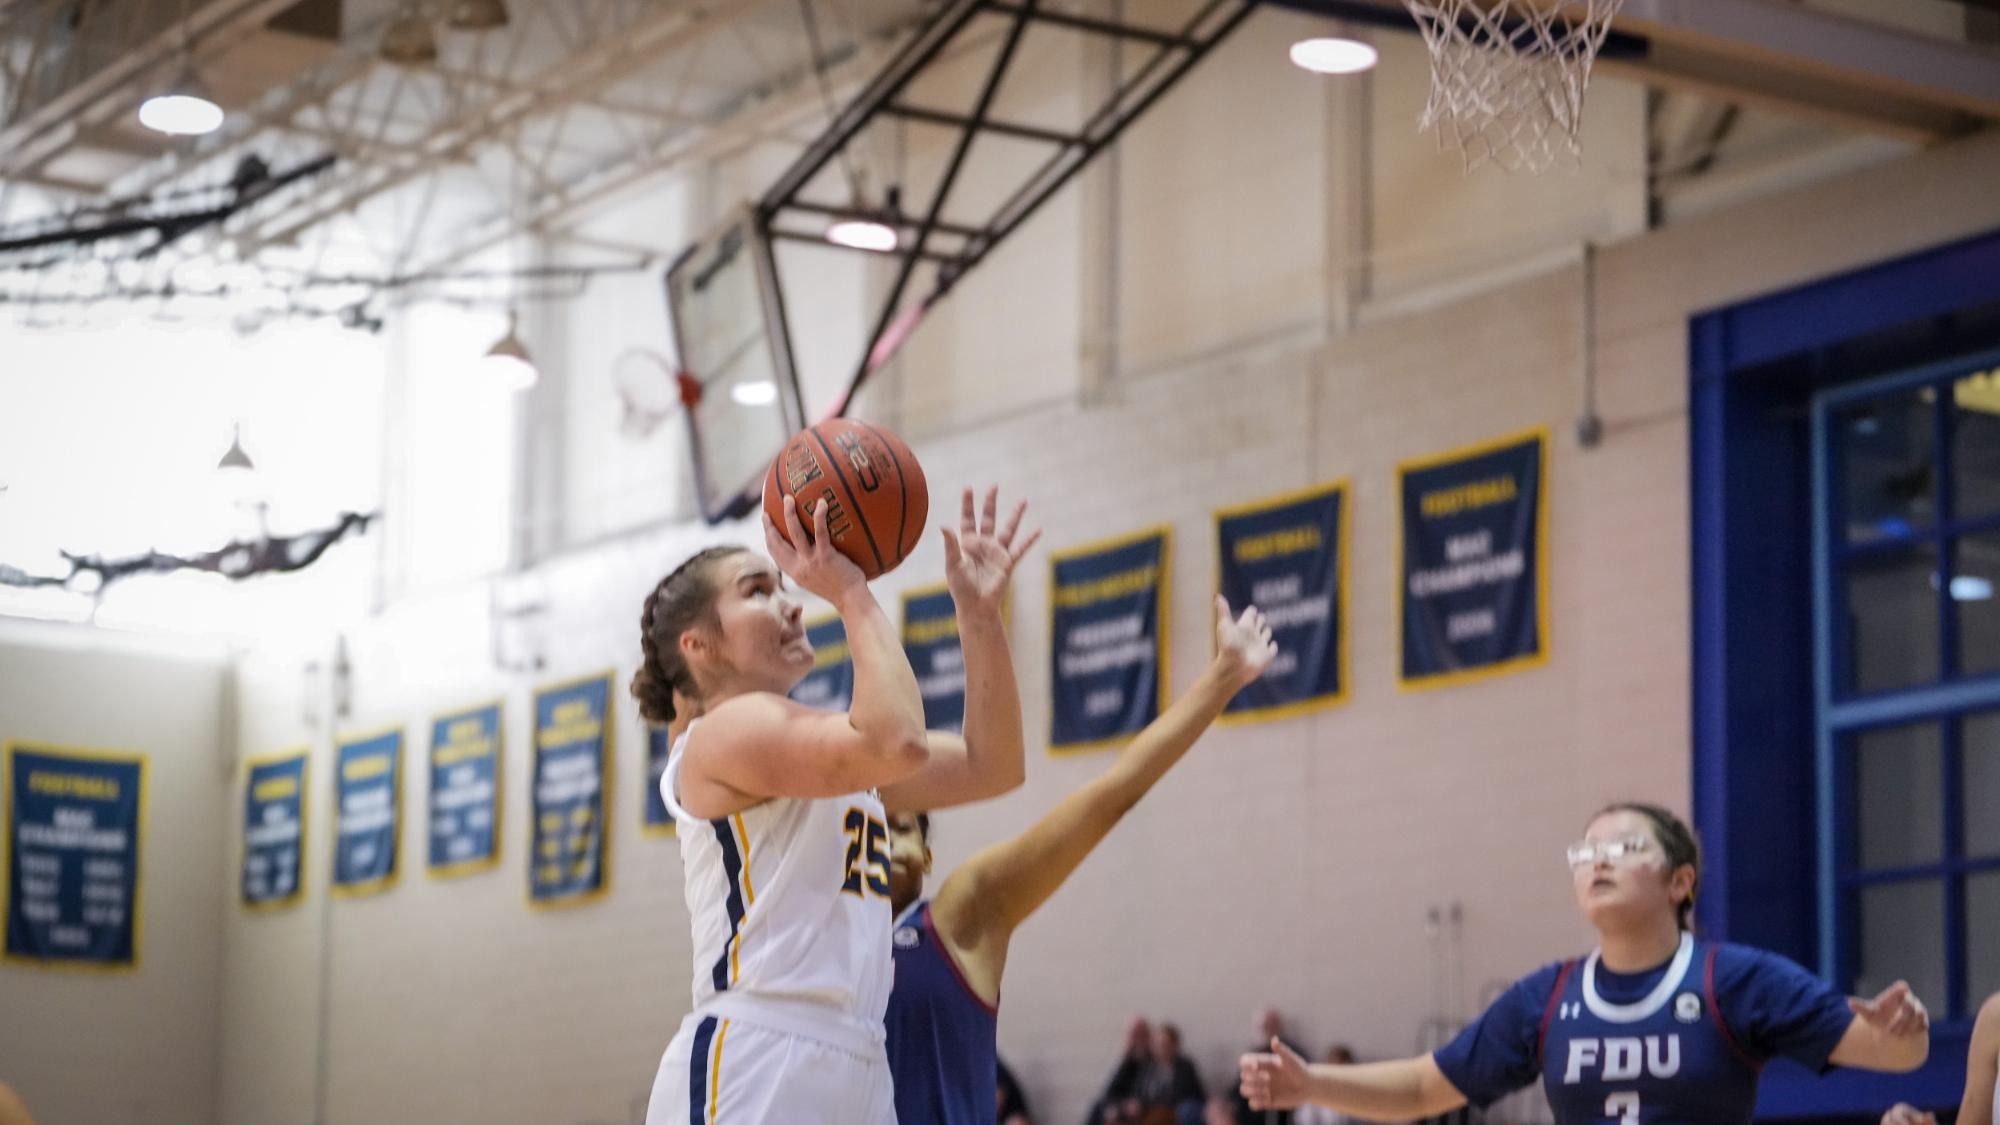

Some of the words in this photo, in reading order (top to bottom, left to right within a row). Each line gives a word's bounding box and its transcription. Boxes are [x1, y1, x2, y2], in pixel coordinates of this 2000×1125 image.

[1421, 475, 1517, 517] FOOTBALL
[1235, 528, 1320, 561] FOOTBALL
[1410, 551, 1524, 595] CHAMPIONS
[28, 771, 120, 801] FOOTBALL
[840, 806, 892, 901] 25
[1562, 1033, 1681, 1086] FDU
